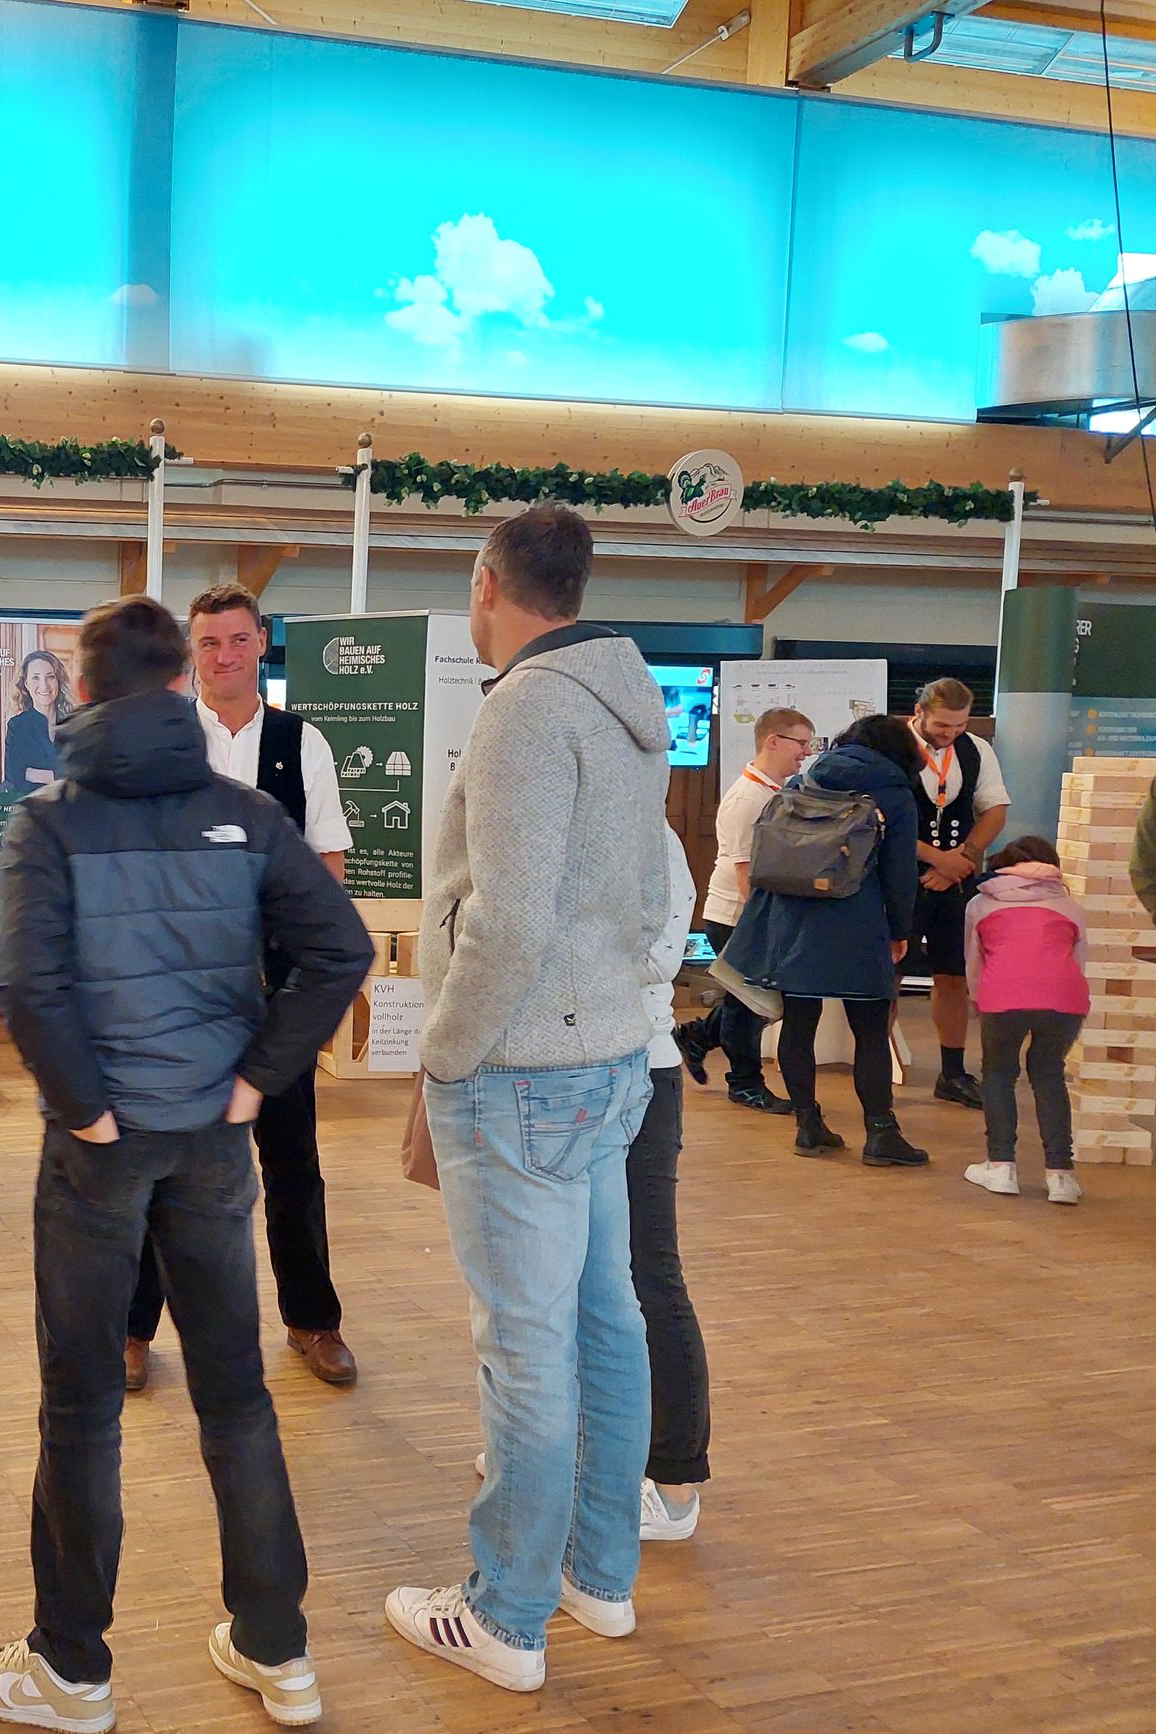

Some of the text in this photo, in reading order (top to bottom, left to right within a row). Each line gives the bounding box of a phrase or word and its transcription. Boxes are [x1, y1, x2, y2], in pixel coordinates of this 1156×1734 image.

[339, 637, 355, 645] WIR
[339, 645, 382, 655] BAUEN AUF
[339, 655, 385, 665] HEIMISCHES
[435, 655, 474, 664] Fachschule
[339, 665, 373, 674] HOLZ e.V.
[438, 676, 474, 684] Holztechnik
[291, 702, 419, 711] WERTSCHÖPFUNGSKETTE HOLZ
[372, 848, 384, 856] alle
[388, 849, 414, 858] Akteure
[344, 858, 398, 867] schöpfungskette
[357, 868, 386, 877] Rohstoff
[356, 879, 386, 888] wertvolle
[386, 880, 402, 888] Holz
[363, 889, 386, 898] halten.
[374, 984, 395, 993] KVH
[373, 1000, 425, 1009] Konstruktion
[372, 1013, 403, 1021] vollholz
